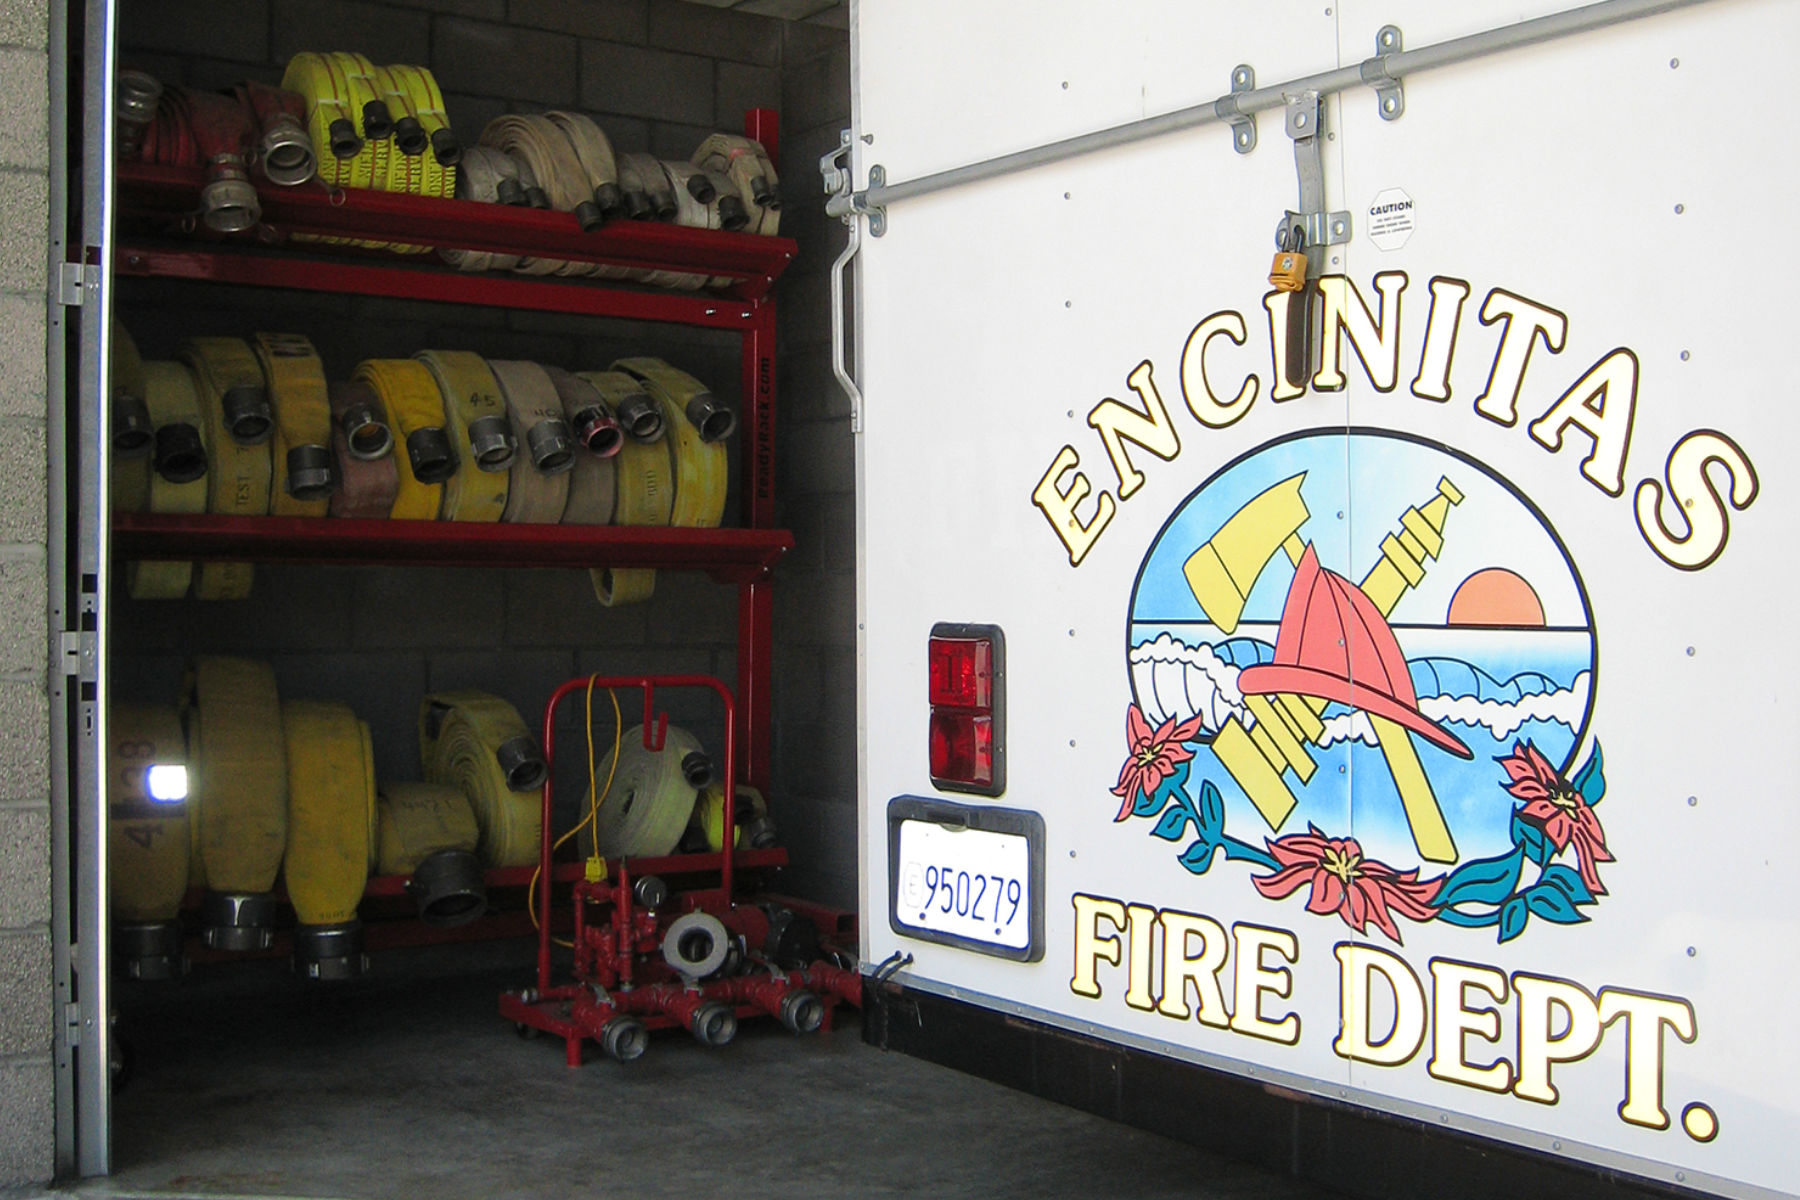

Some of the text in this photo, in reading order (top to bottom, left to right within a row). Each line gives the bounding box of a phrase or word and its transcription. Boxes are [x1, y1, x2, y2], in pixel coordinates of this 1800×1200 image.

[1370, 201, 1413, 216] CAUTION
[758, 357, 771, 499] ReadyRack.com
[1031, 271, 1759, 571] ENCINITAS
[924, 865, 1022, 926] 950279
[1071, 892, 1719, 1142] FIRE DEPT.
